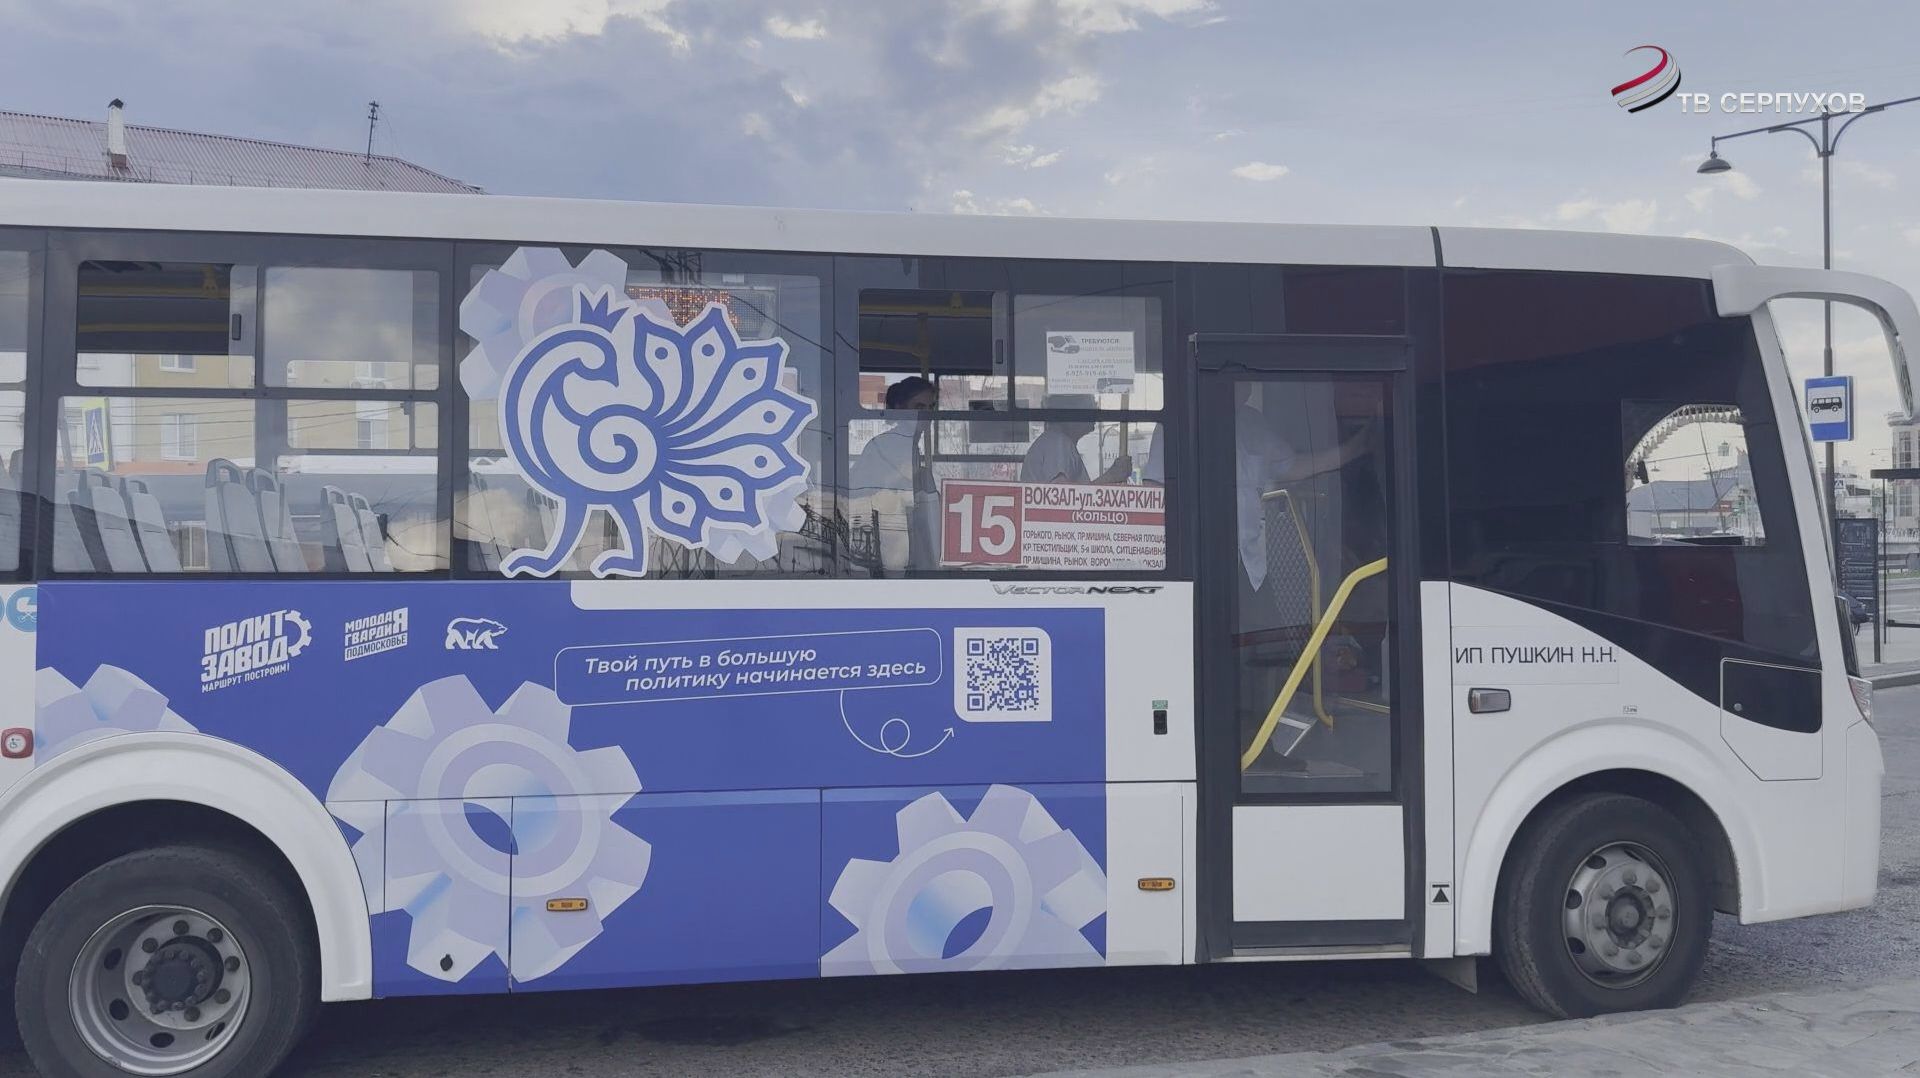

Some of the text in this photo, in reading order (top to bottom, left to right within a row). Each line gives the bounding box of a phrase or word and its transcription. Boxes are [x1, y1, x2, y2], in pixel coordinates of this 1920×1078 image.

[949, 494, 1016, 556] 15
[1072, 510, 1128, 524] (КОЛЬЦО)
[1080, 544, 1090, 553] 5-я
[1113, 532, 1142, 543] СЕВЕРНАЯ
[204, 609, 288, 655] ПОЛИТ
[200, 635, 289, 683] ЗАВОД
[346, 634, 408, 659] ПОДМОСКОВЬЕ
[1455, 646, 1617, 664] ИП ПУШКИН Н.Н.
[585, 648, 817, 674] Твой путь в большую
[201, 662, 290, 693] МАРШРУТ ПОСТРОИМ!
[625, 661, 926, 691] политику начинается здесь
